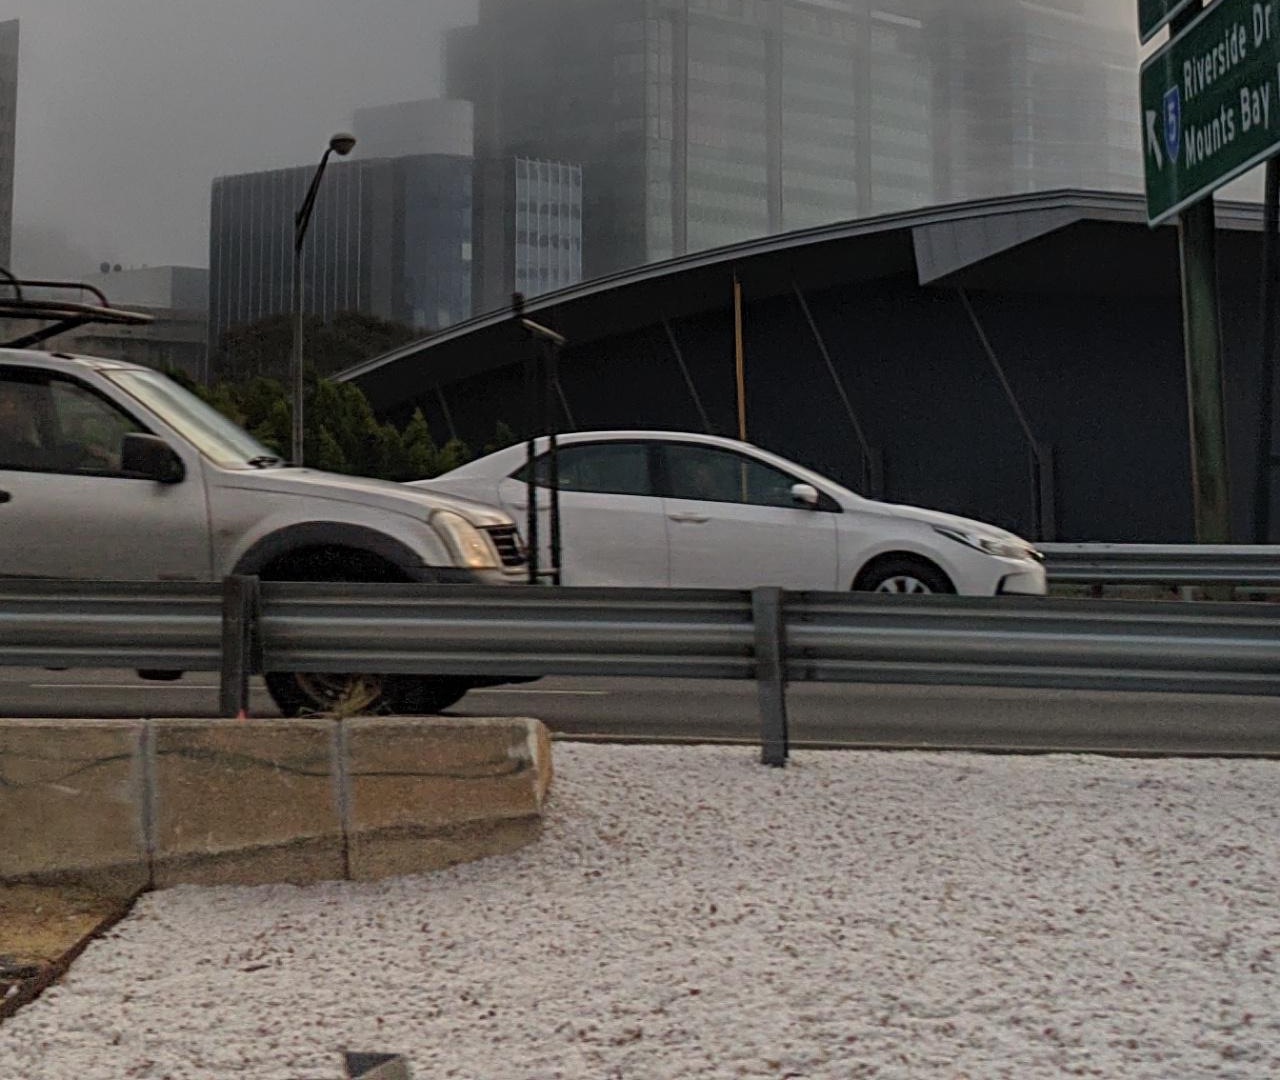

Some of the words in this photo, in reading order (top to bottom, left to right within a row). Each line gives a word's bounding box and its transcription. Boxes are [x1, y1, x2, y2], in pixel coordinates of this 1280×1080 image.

[1183, 22, 1246, 101] Riverside
[1253, 2, 1272, 50] Dr
[1184, 103, 1235, 170] Mounts
[1240, 81, 1270, 134] Bay
